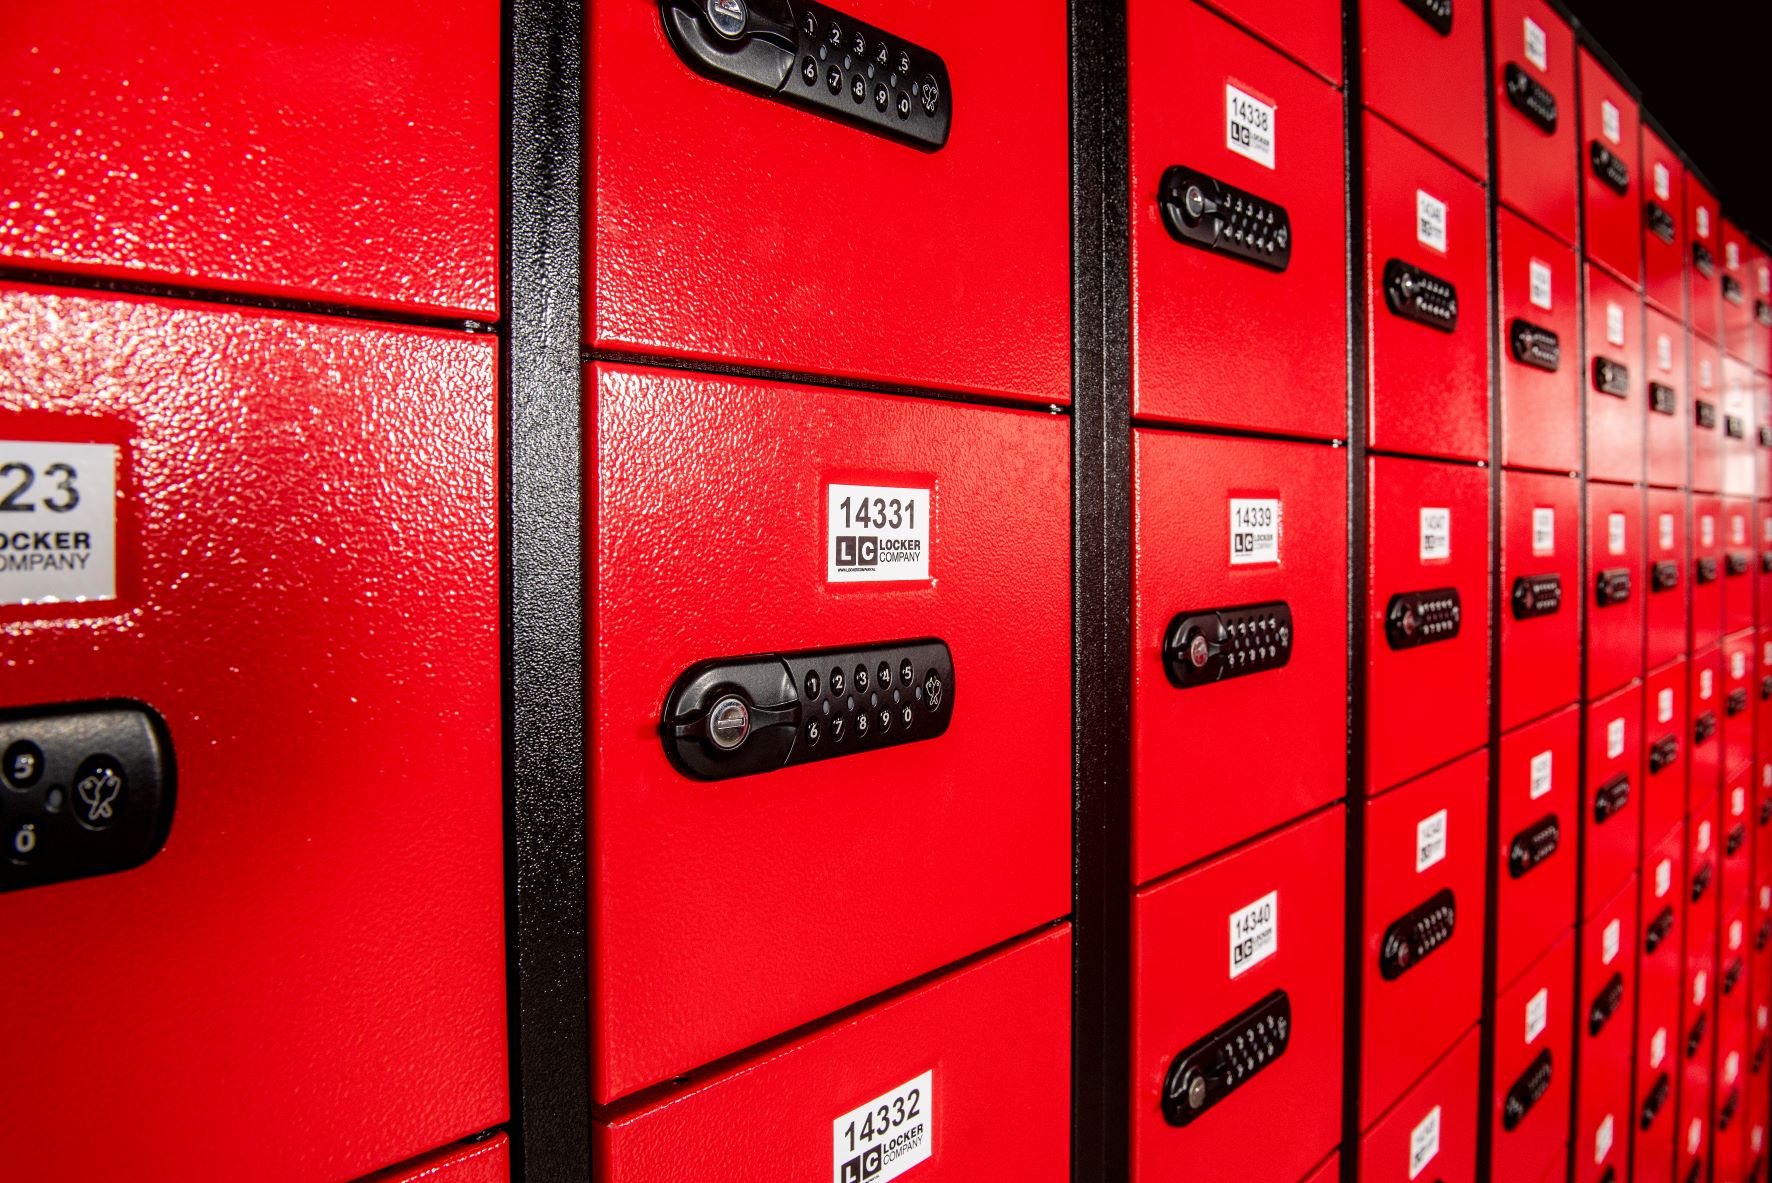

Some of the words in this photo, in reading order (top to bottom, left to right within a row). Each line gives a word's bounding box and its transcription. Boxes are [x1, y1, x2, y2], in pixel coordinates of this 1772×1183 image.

[807, 18, 814, 33] 1
[832, 29, 840, 44] 2
[856, 39, 864, 53] 3
[880, 49, 887, 63] 4
[901, 57, 909, 71] 5
[807, 63, 815, 78] 6
[832, 72, 840, 87] 7
[856, 81, 864, 96] 8
[879, 90, 886, 104] 9
[901, 99, 909, 113] 0
[1232, 97, 1268, 131] 14338
[0, 462, 80, 513] 23
[840, 496, 914, 529] 14331
[1236, 507, 1271, 528] 14339
[879, 539, 920, 551] LOCKER
[879, 551, 920, 563] COMPANY
[811, 678, 817, 692] 1
[835, 675, 843, 689] 2
[859, 671, 867, 685] 3
[882, 668, 890, 682] 4
[904, 666, 912, 680] 5
[810, 723, 818, 738] 6
[835, 720, 843, 735] 7
[859, 715, 867, 730] 8
[882, 712, 890, 726] 9
[904, 708, 912, 722] 0
[1236, 903, 1271, 939] 14340
[845, 1088, 920, 1152] 14332
[883, 1124, 924, 1154] LOCKER
[883, 1135, 924, 1165] COMPANY
